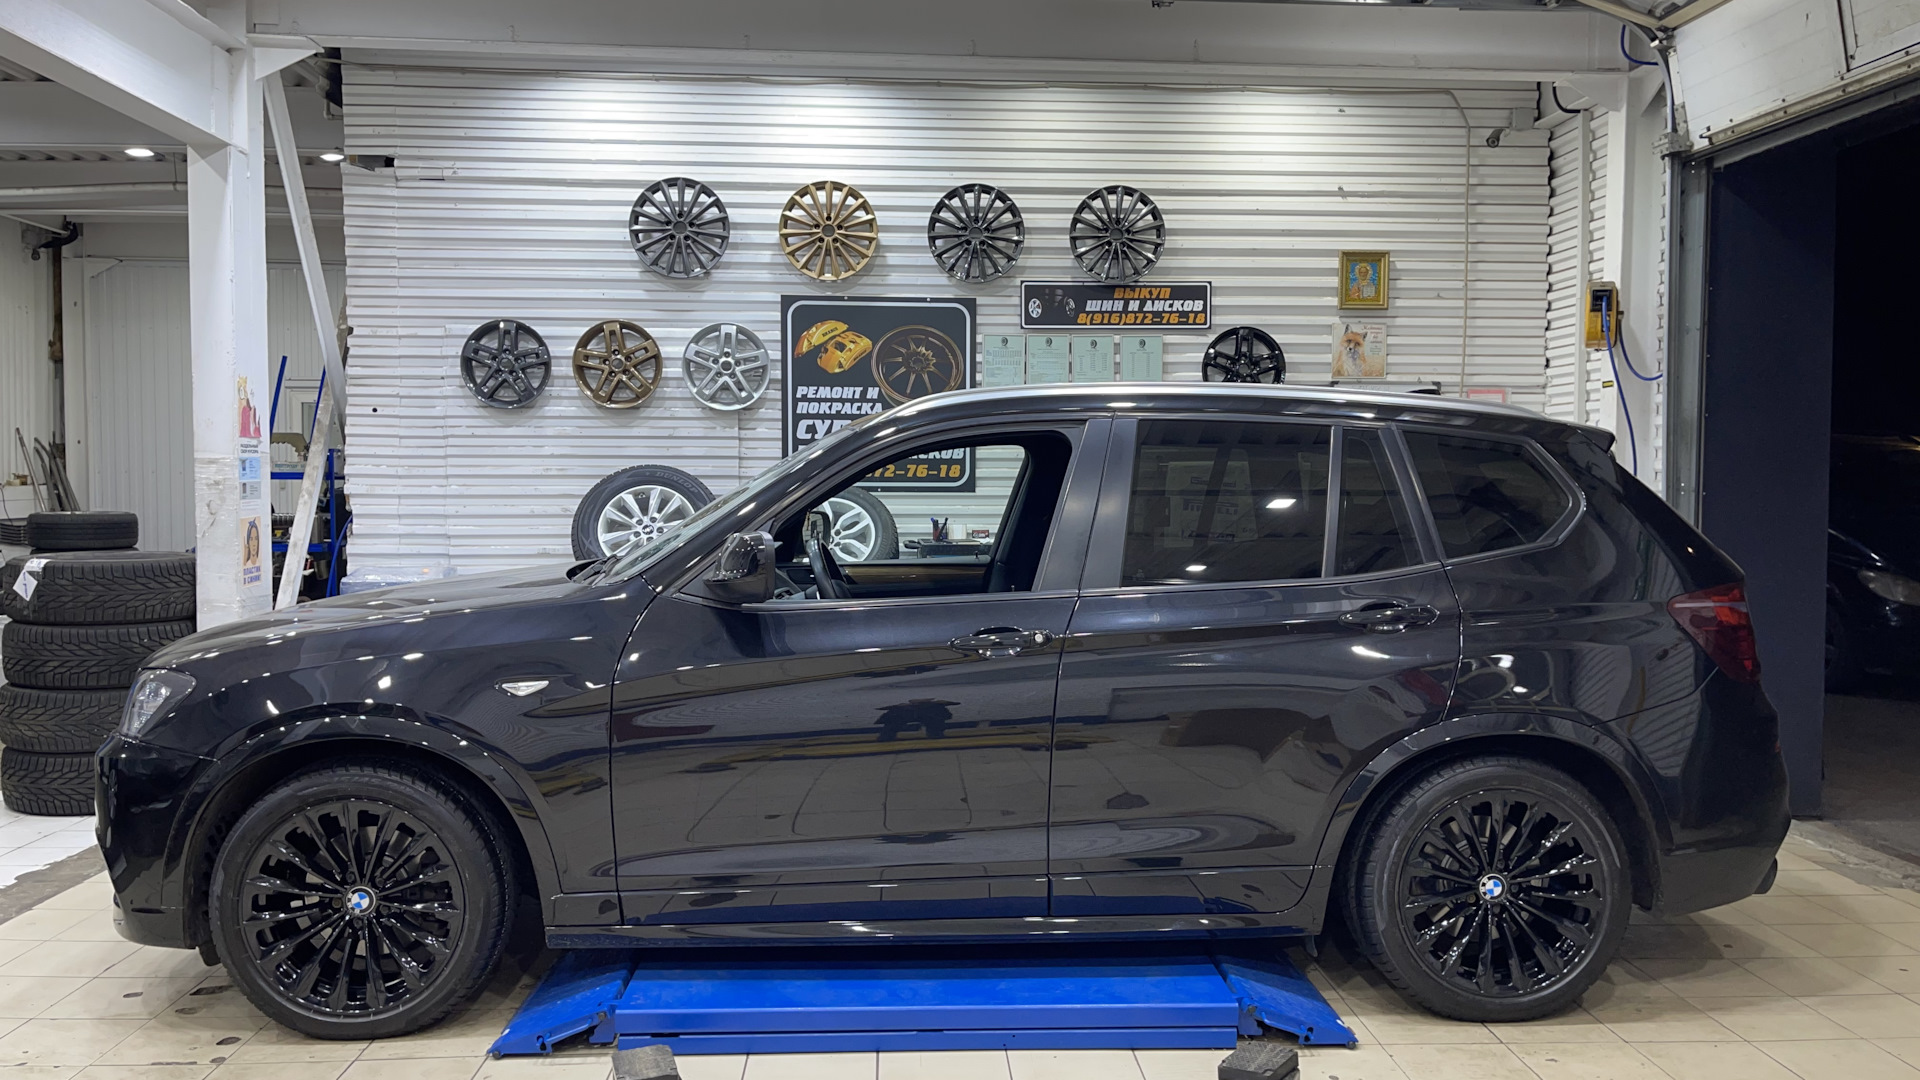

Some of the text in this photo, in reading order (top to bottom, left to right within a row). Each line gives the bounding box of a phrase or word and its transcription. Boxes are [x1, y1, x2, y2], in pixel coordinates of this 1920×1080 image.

[1113, 287, 1171, 299] ВЫКУП
[1085, 299, 1204, 312] ШИН И ДИСКОВ
[1077, 312, 1206, 326] 8(916)872-76-18
[796, 385, 880, 400] РЕМОНТ И
[796, 401, 883, 415] ПОКРАСКА
[656, 471, 699, 493] DUNLOP
